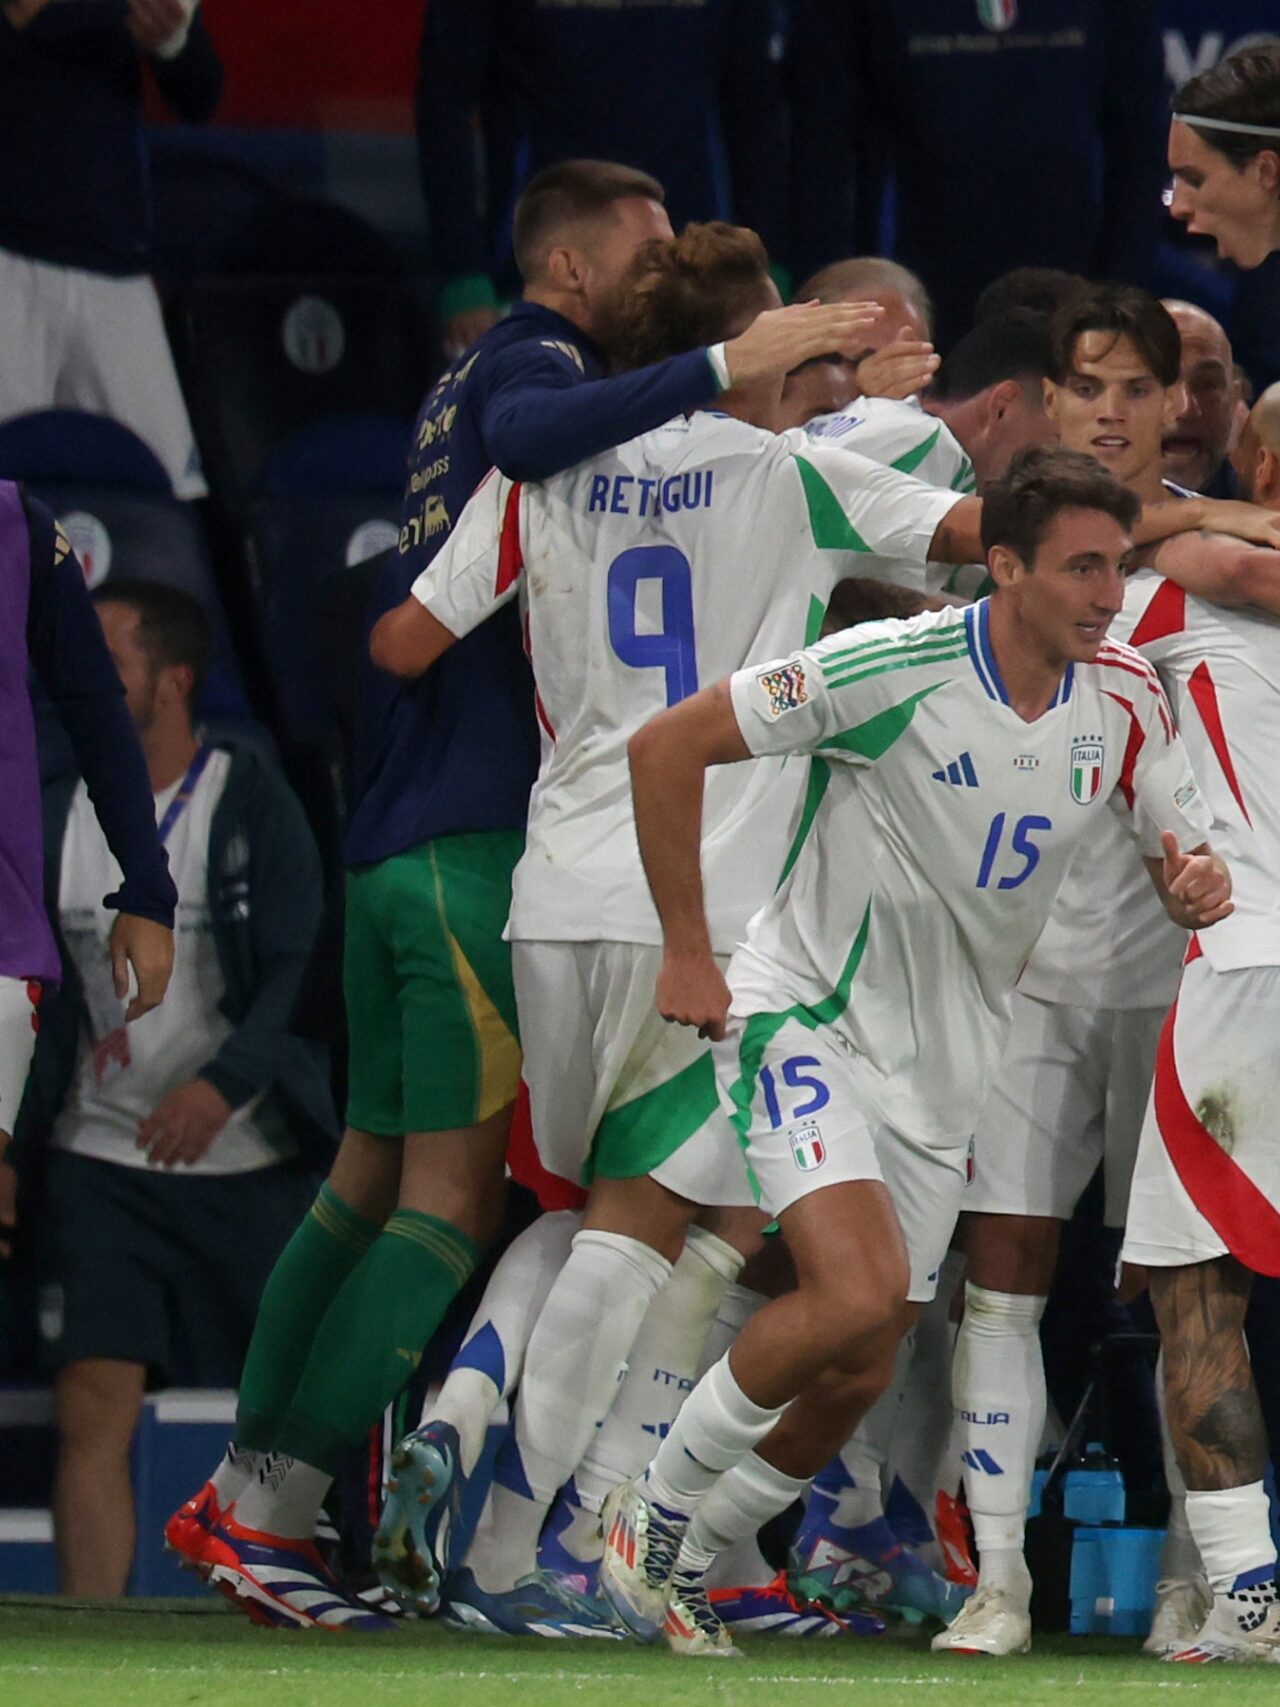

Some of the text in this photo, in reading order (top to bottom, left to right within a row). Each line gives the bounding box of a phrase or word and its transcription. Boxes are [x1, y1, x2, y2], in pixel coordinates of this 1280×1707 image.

[607, 544, 699, 709] 9
[1073, 750, 1101, 762] ITALIA
[976, 811, 1052, 890] 15
[759, 1055, 831, 1131] 15
[652, 1368, 696, 1393] ITA
[959, 1409, 1010, 1425] ALIA
